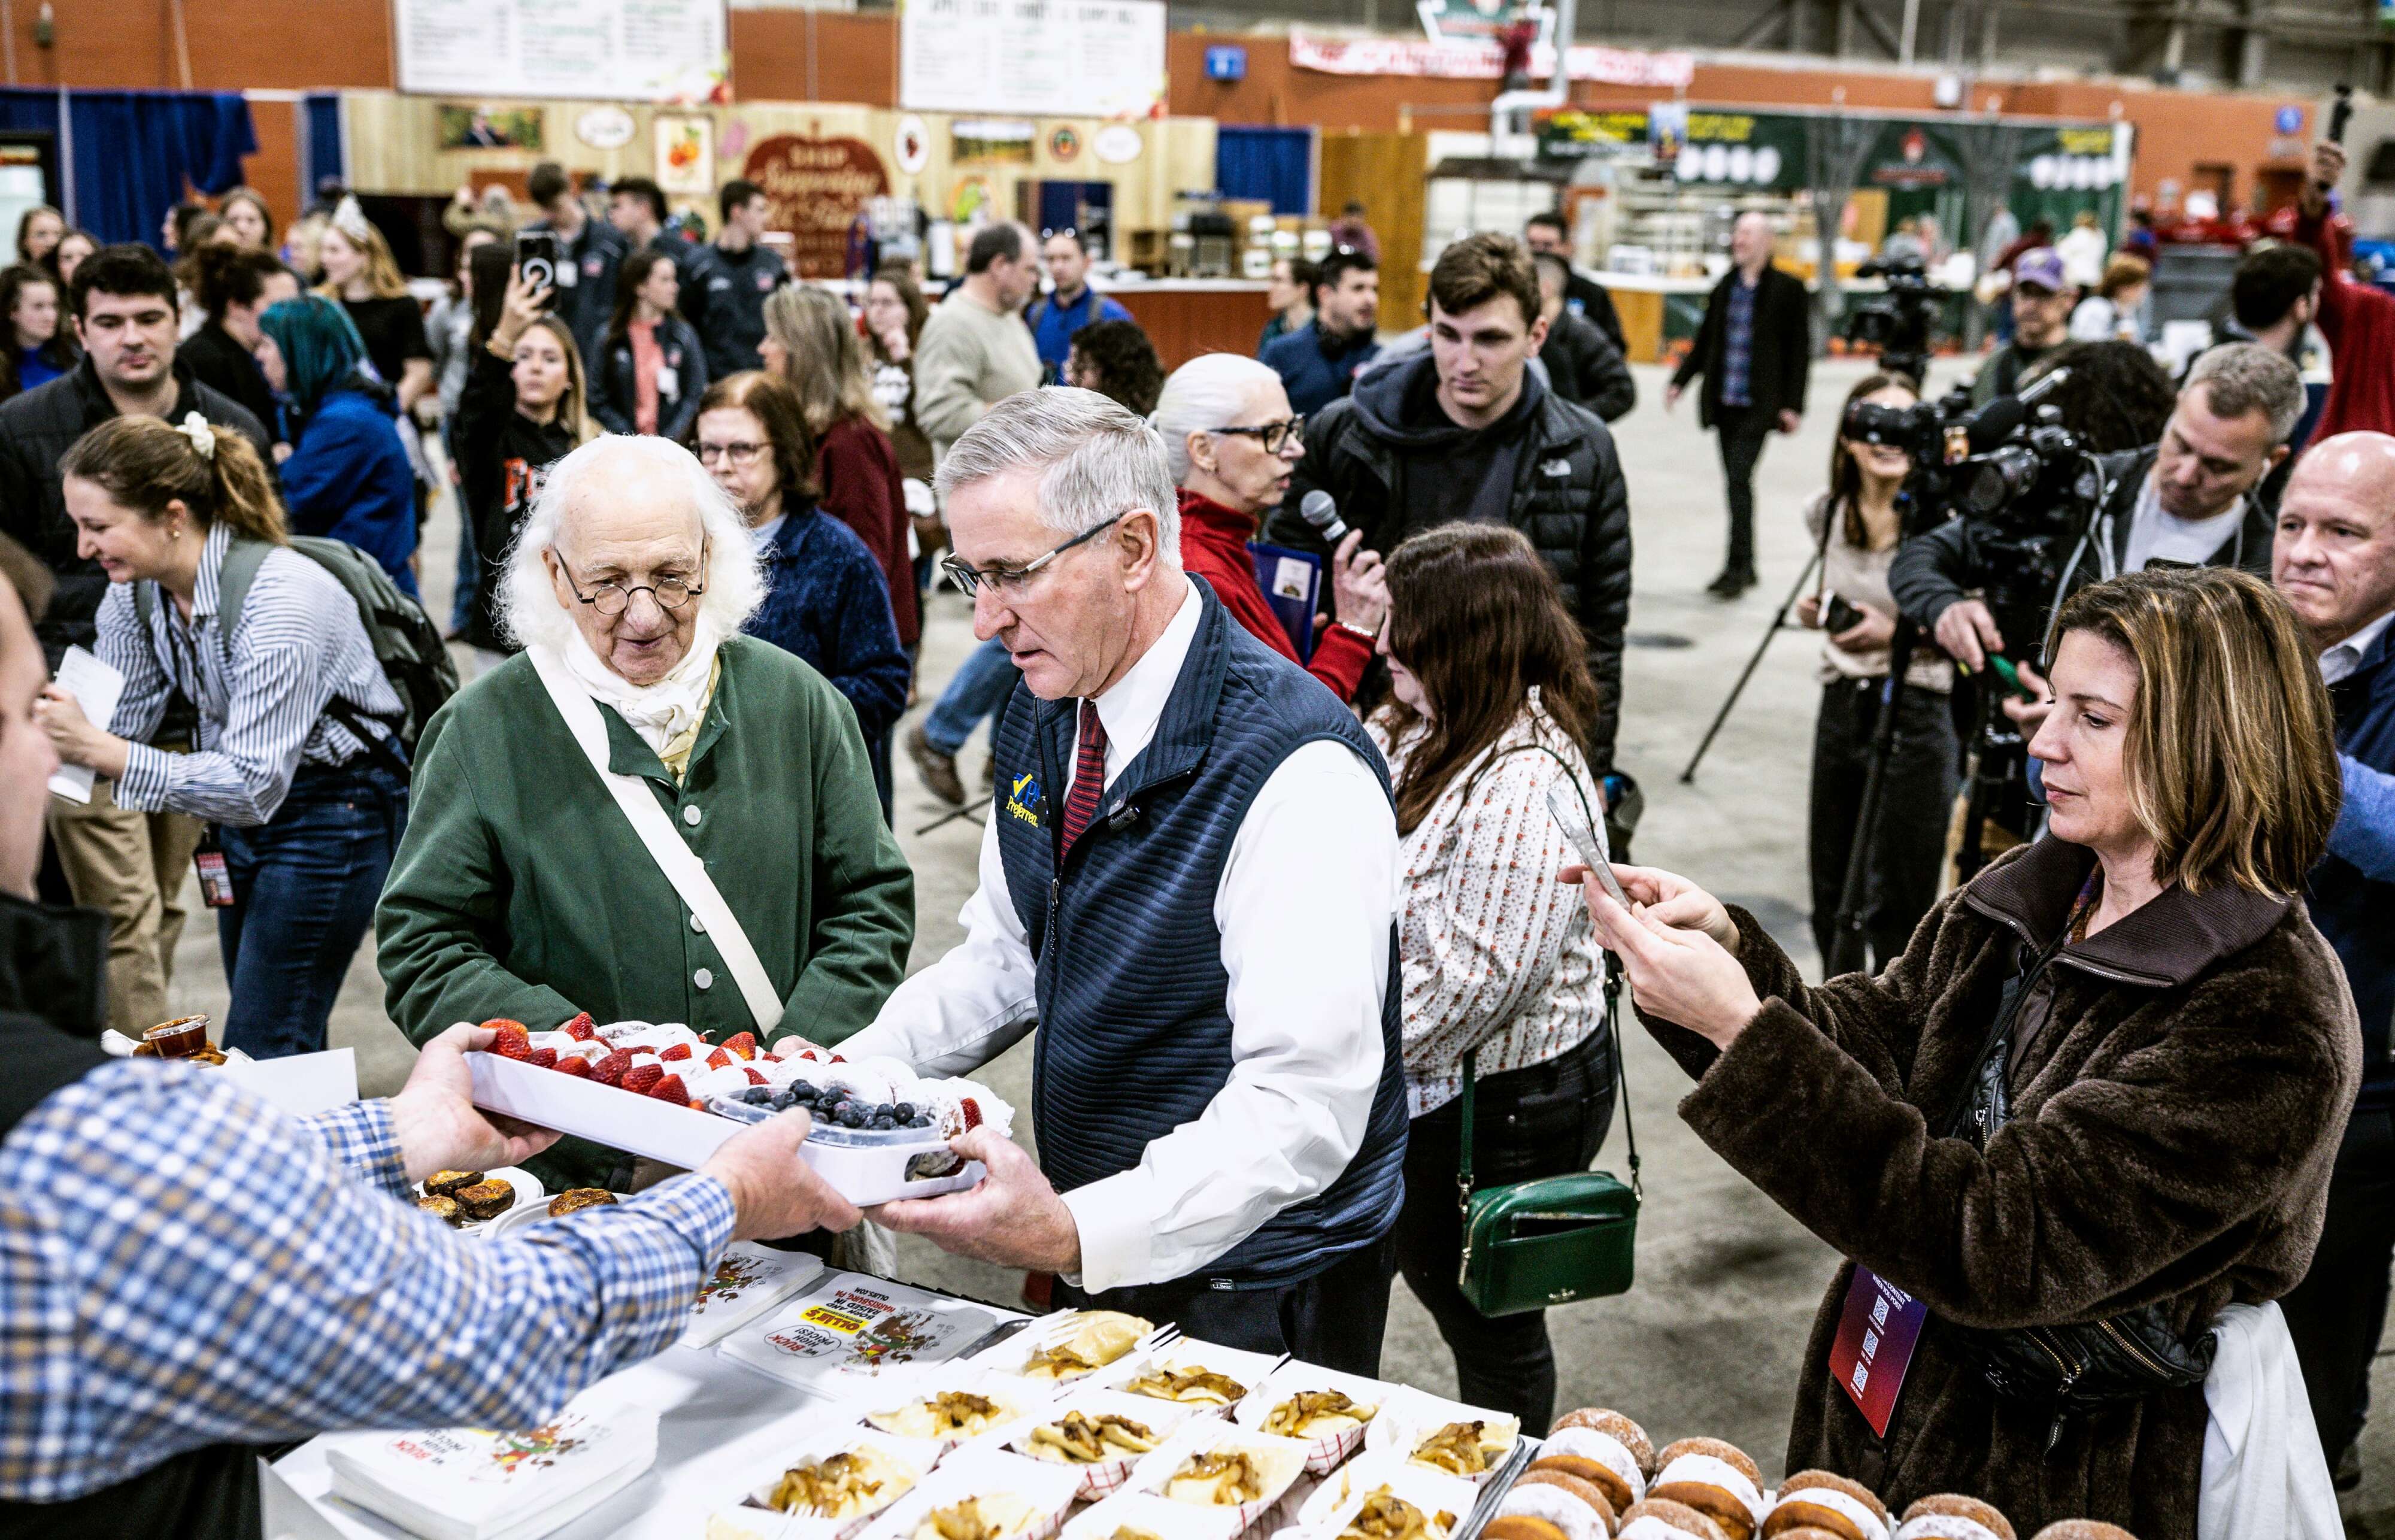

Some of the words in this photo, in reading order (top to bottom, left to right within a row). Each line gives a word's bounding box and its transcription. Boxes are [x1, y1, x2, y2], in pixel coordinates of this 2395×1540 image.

[834, 1290, 845, 1298] PA
[1873, 1274, 1883, 1291] WHEN
[1882, 1287, 1891, 1301] YOU
[1887, 1283, 1905, 1305] CONTENT
[825, 1302, 847, 1311] AND
[847, 1292, 896, 1313] HARRISBURG,
[848, 1302, 881, 1315] RAISED
[848, 1309, 875, 1320] BORN
[768, 1334, 806, 1352] BUCK
[792, 1335, 820, 1348] HIGH
[793, 1327, 835, 1346] PRICES!
[802, 1347, 818, 1357] WE
